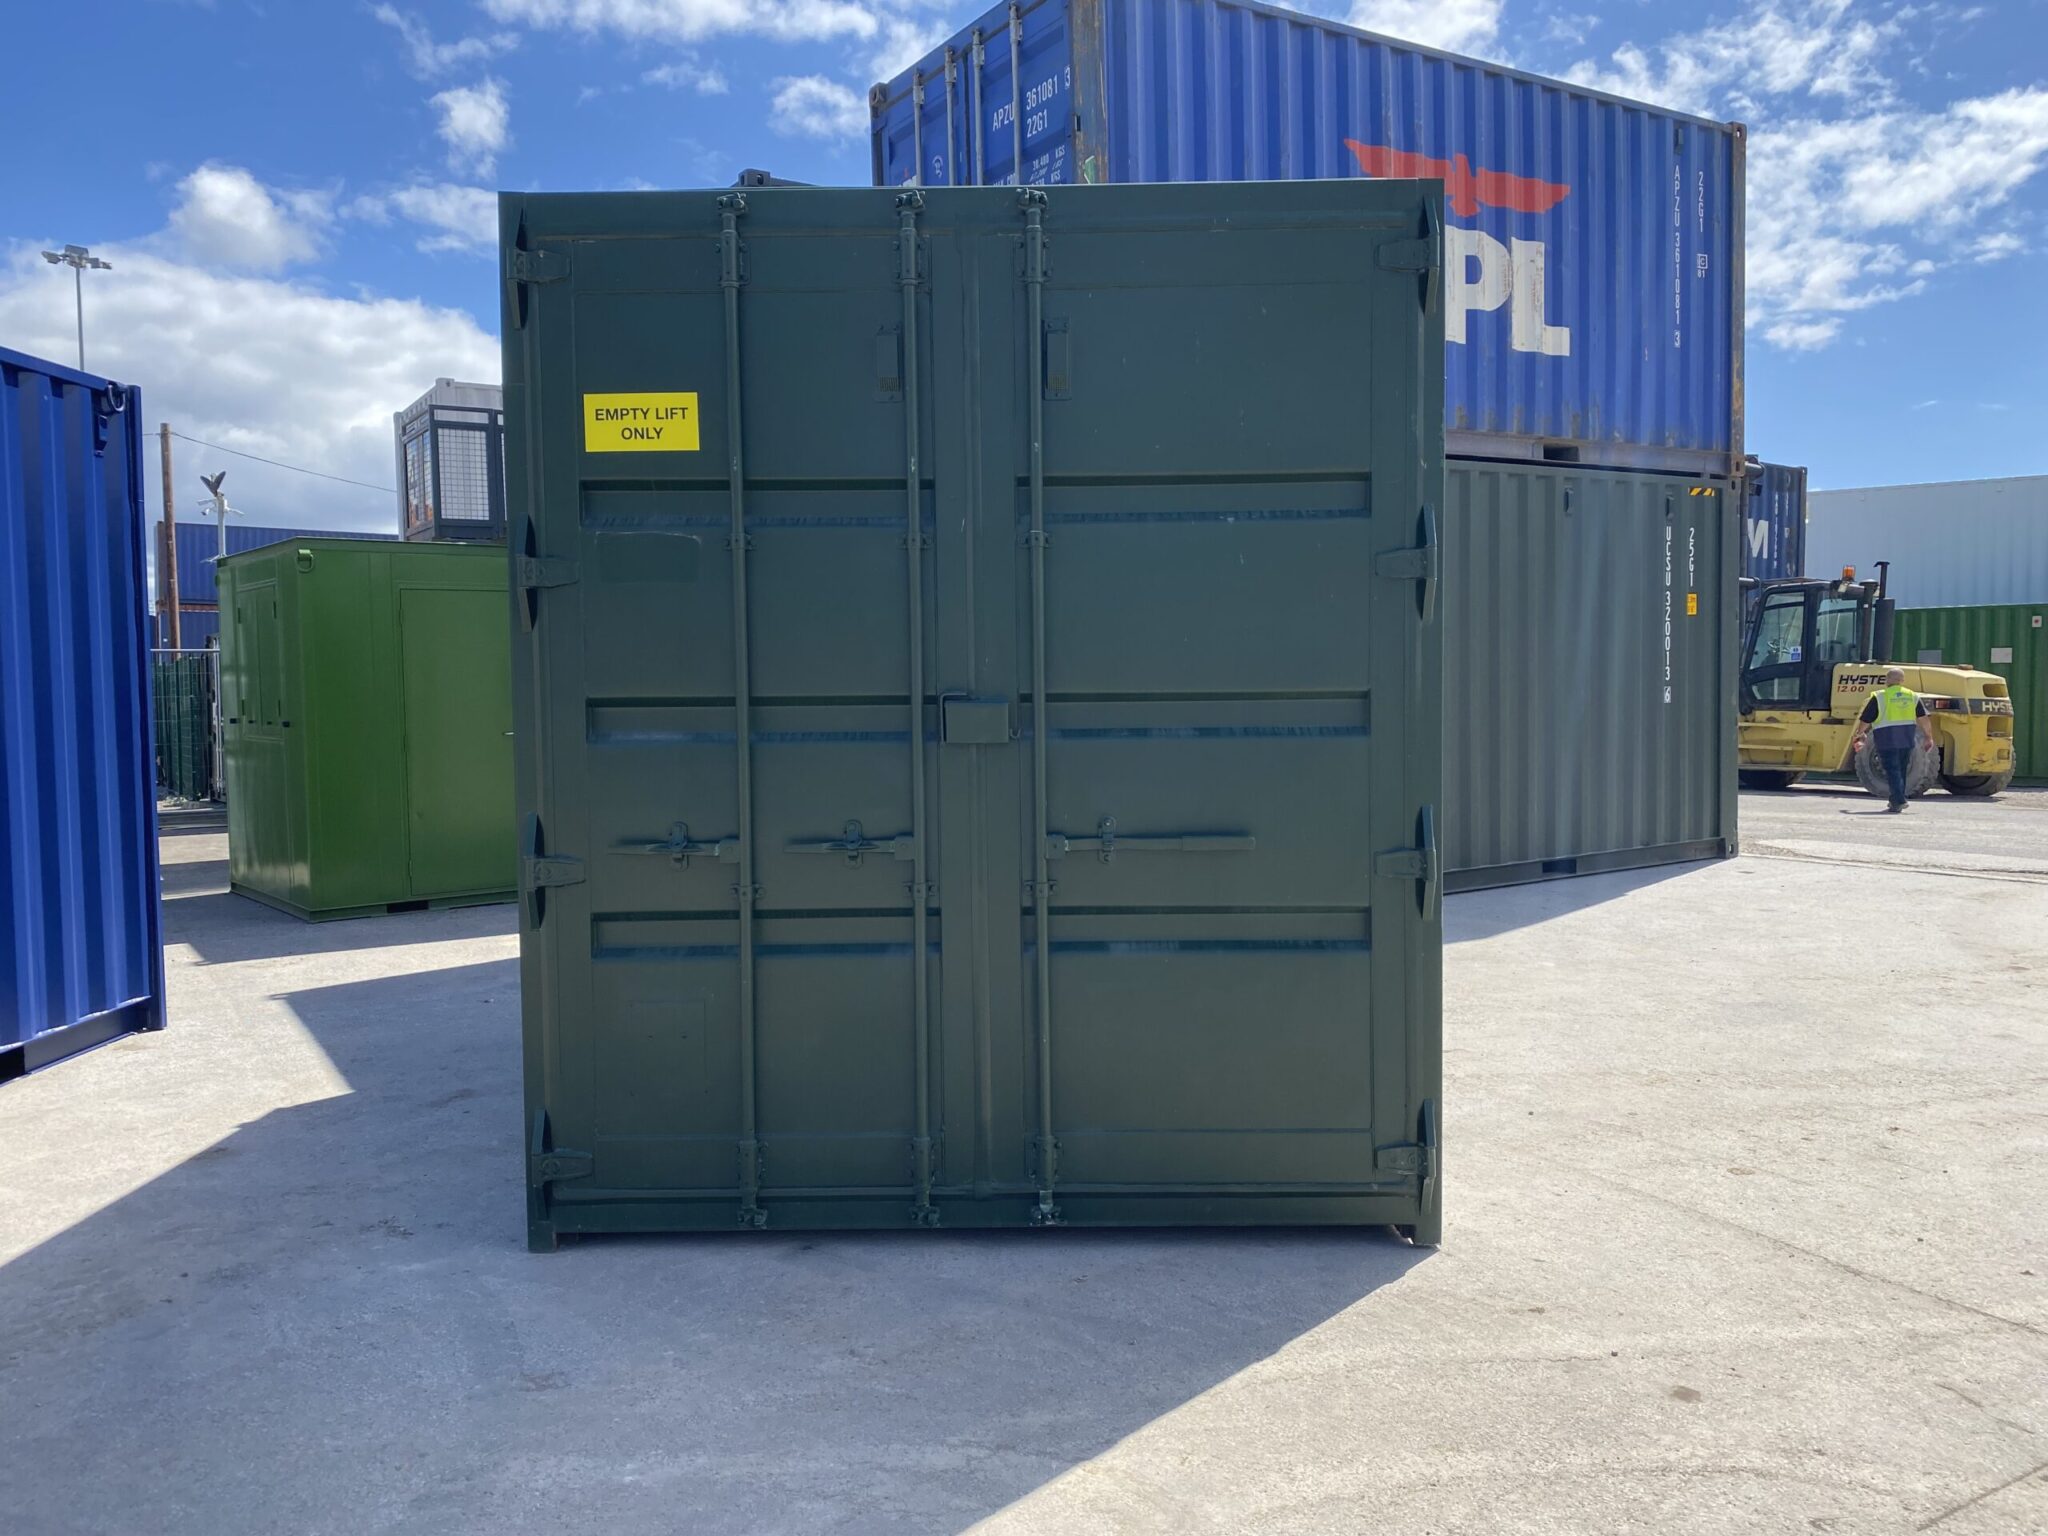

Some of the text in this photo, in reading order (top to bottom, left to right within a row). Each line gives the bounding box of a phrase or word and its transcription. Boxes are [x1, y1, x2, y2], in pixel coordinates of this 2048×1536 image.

[992, 65, 1071, 132] APZU 361081 3
[1026, 109, 1048, 138] 22G1
[1673, 165, 1681, 348] APZU 361081 3
[1445, 224, 1570, 357] PL
[594, 407, 689, 421] EMPTY LIFT
[621, 426, 664, 440] ONLY
[1664, 591, 1672, 681] 320013
[1838, 674, 1887, 685] HYSTE
[1664, 686, 1671, 703] 6
